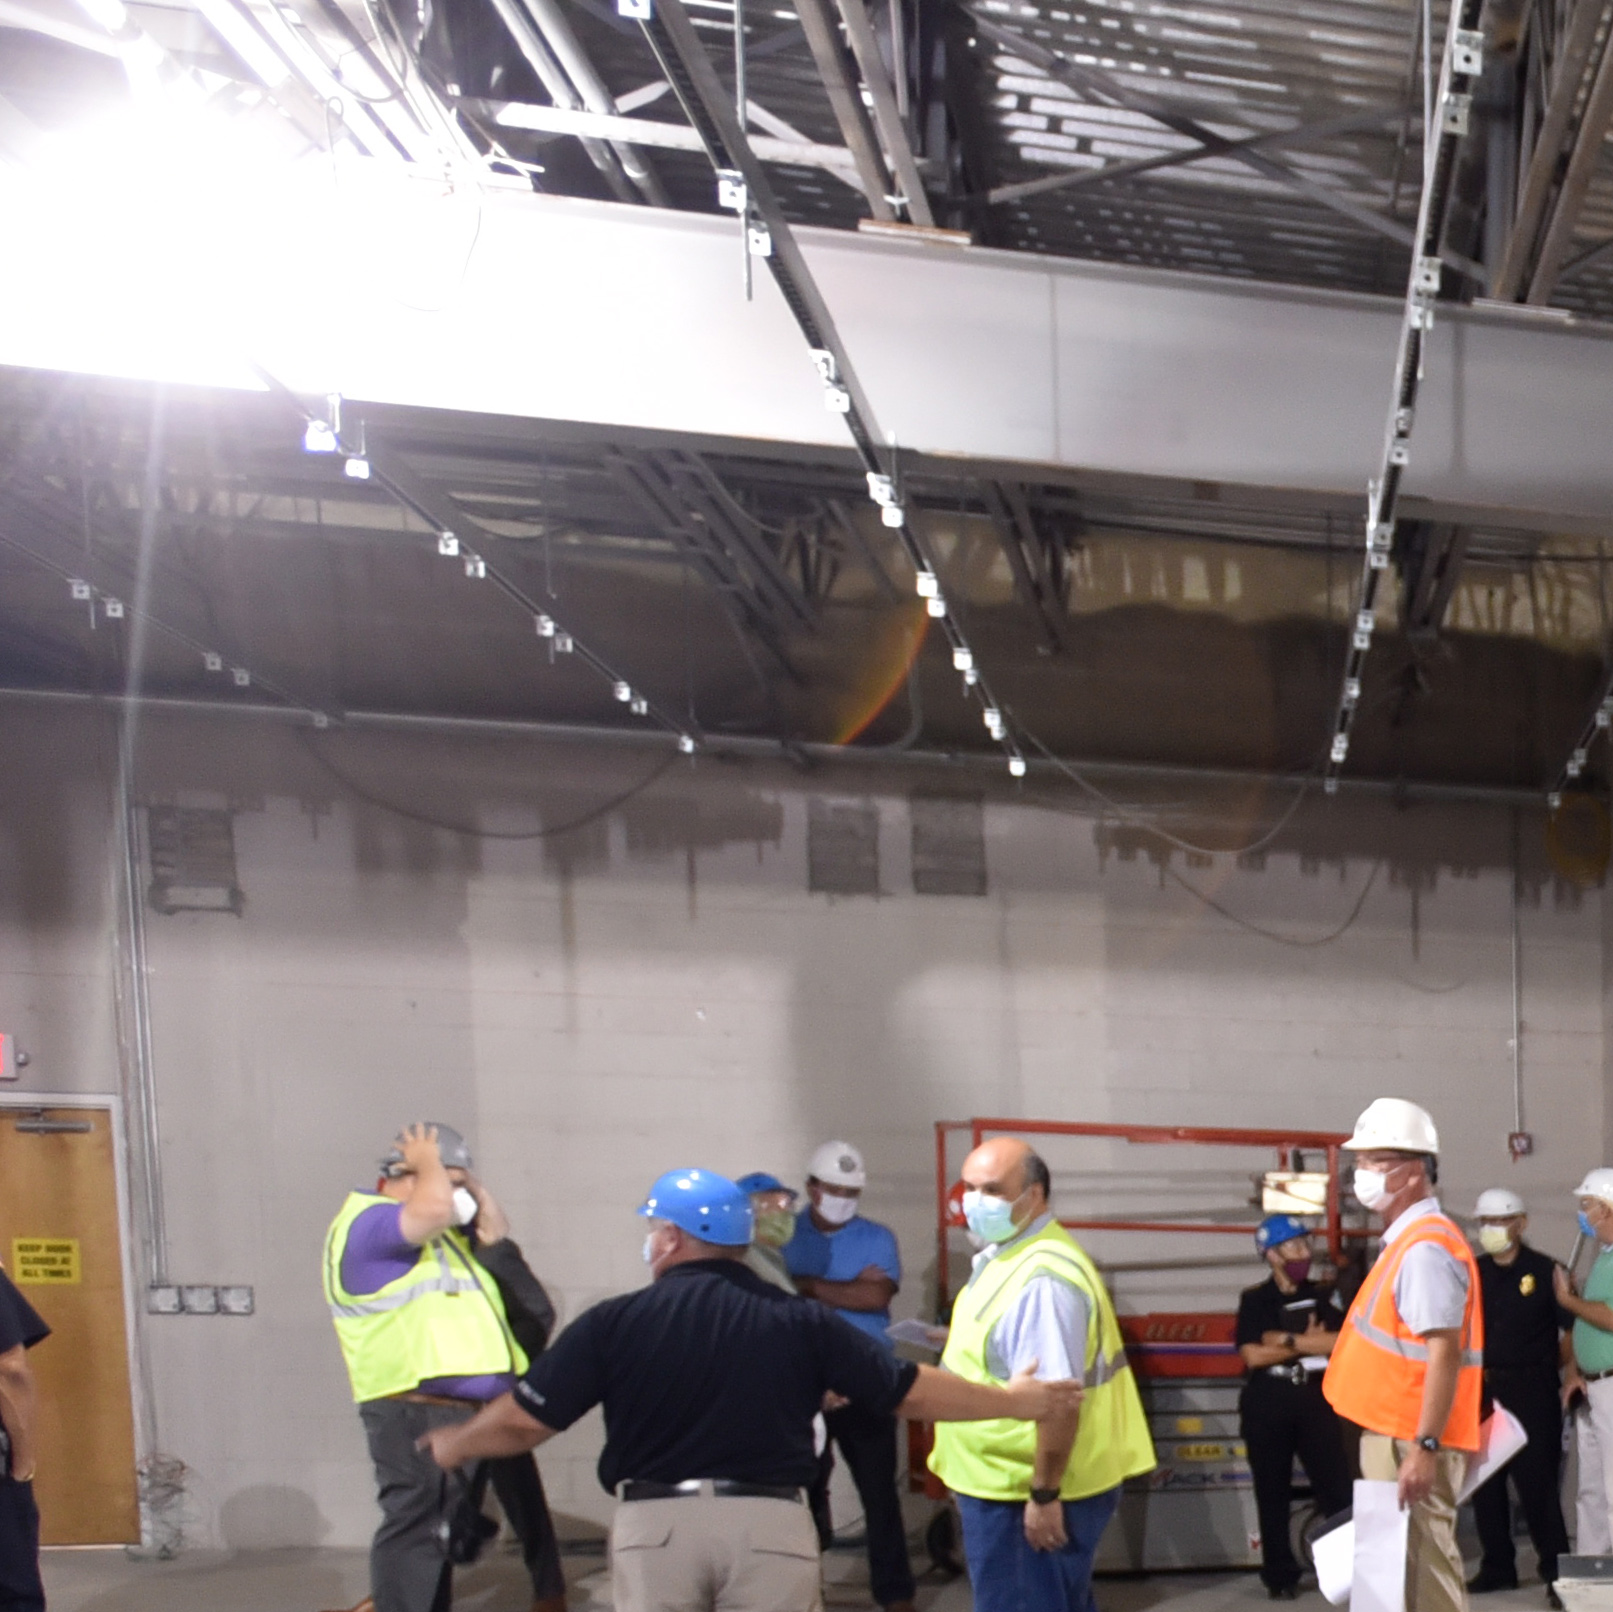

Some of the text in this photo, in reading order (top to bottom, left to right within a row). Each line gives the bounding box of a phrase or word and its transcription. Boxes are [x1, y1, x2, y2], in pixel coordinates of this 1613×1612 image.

[20, 1256, 57, 1265] CLOSED
[22, 1269, 72, 1277] ALL TIMES
